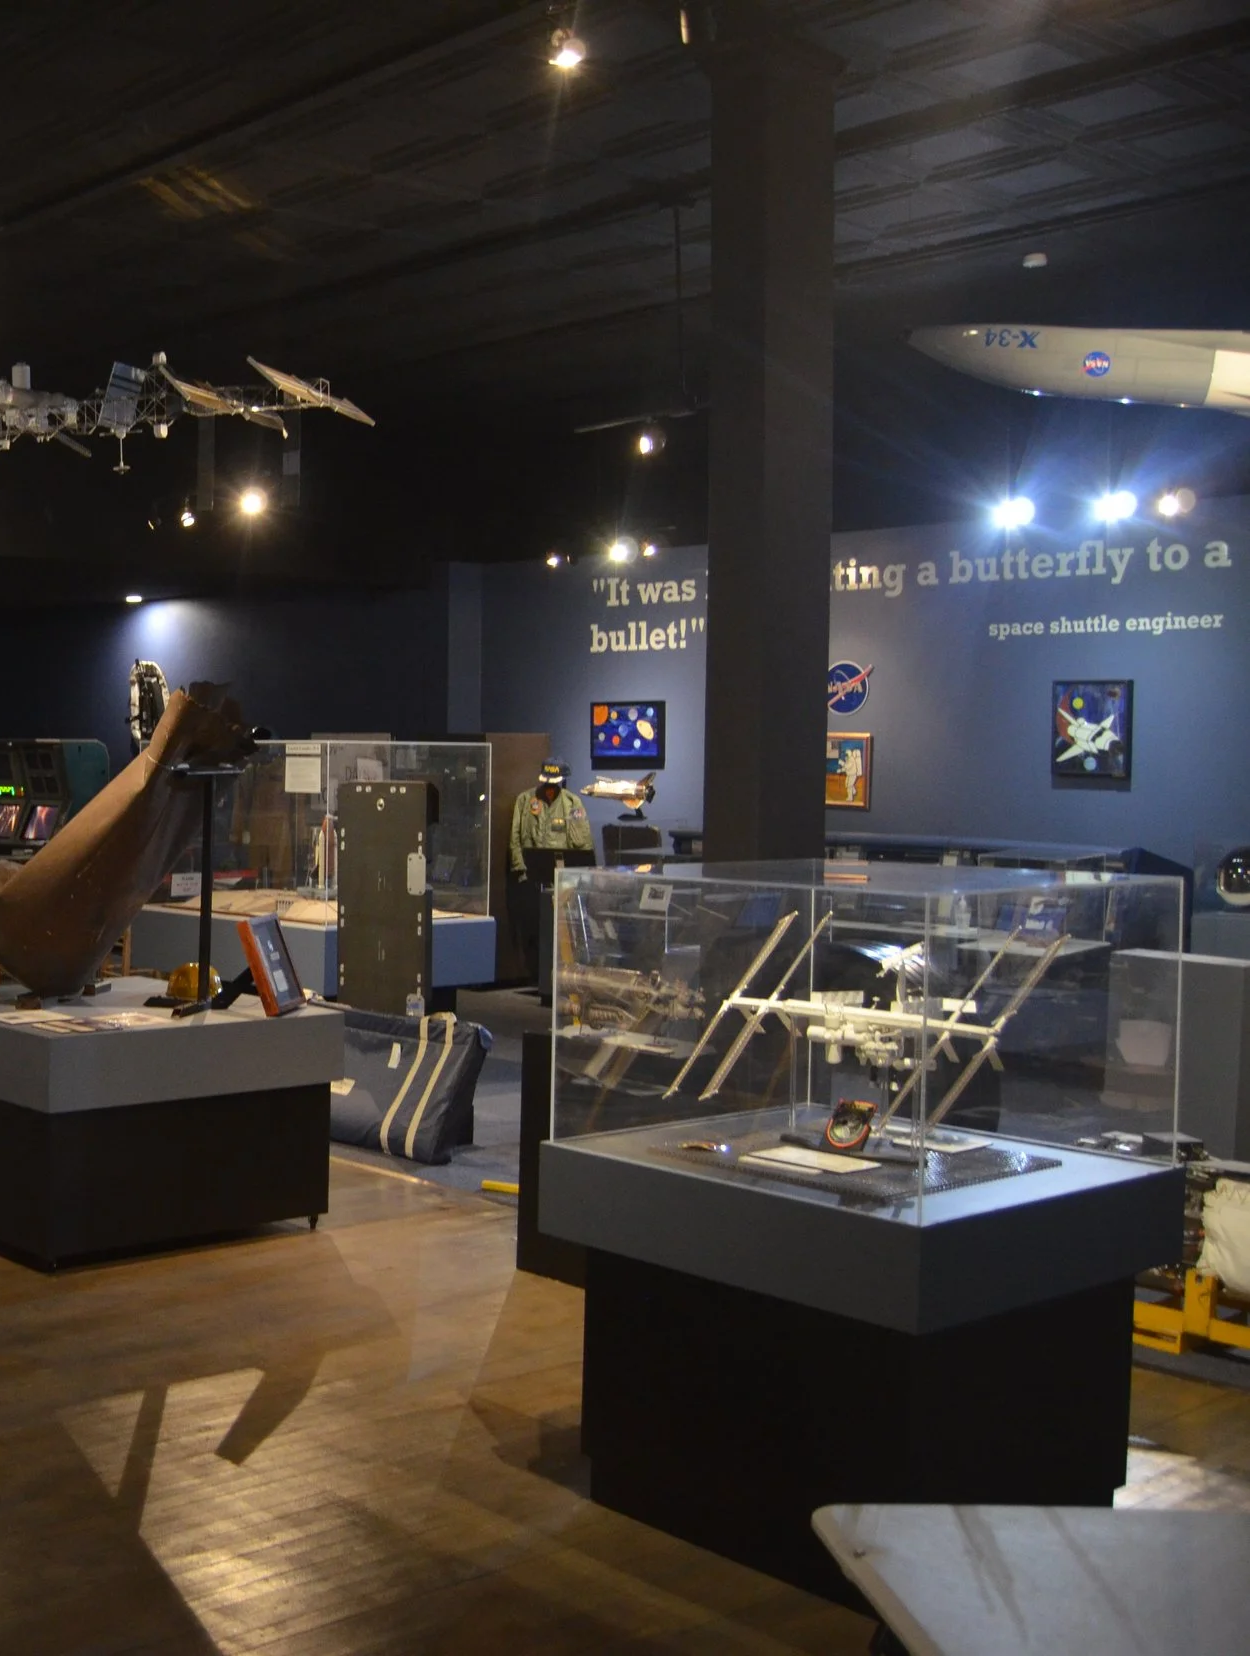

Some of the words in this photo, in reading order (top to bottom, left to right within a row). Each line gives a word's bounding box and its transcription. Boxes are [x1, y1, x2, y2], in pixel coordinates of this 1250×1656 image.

[985, 328, 1040, 348] X-34
[592, 577, 630, 606] "It
[637, 578, 696, 605] was
[830, 557, 907, 597] ting
[916, 560, 939, 586] a
[949, 540, 1134, 585] butterfly
[1146, 537, 1189, 572] to
[1203, 539, 1232, 568] a
[590, 616, 705, 653] bullet!"
[989, 619, 1045, 640] space
[1049, 614, 1119, 633] shuttle
[1125, 611, 1224, 635] engineer
